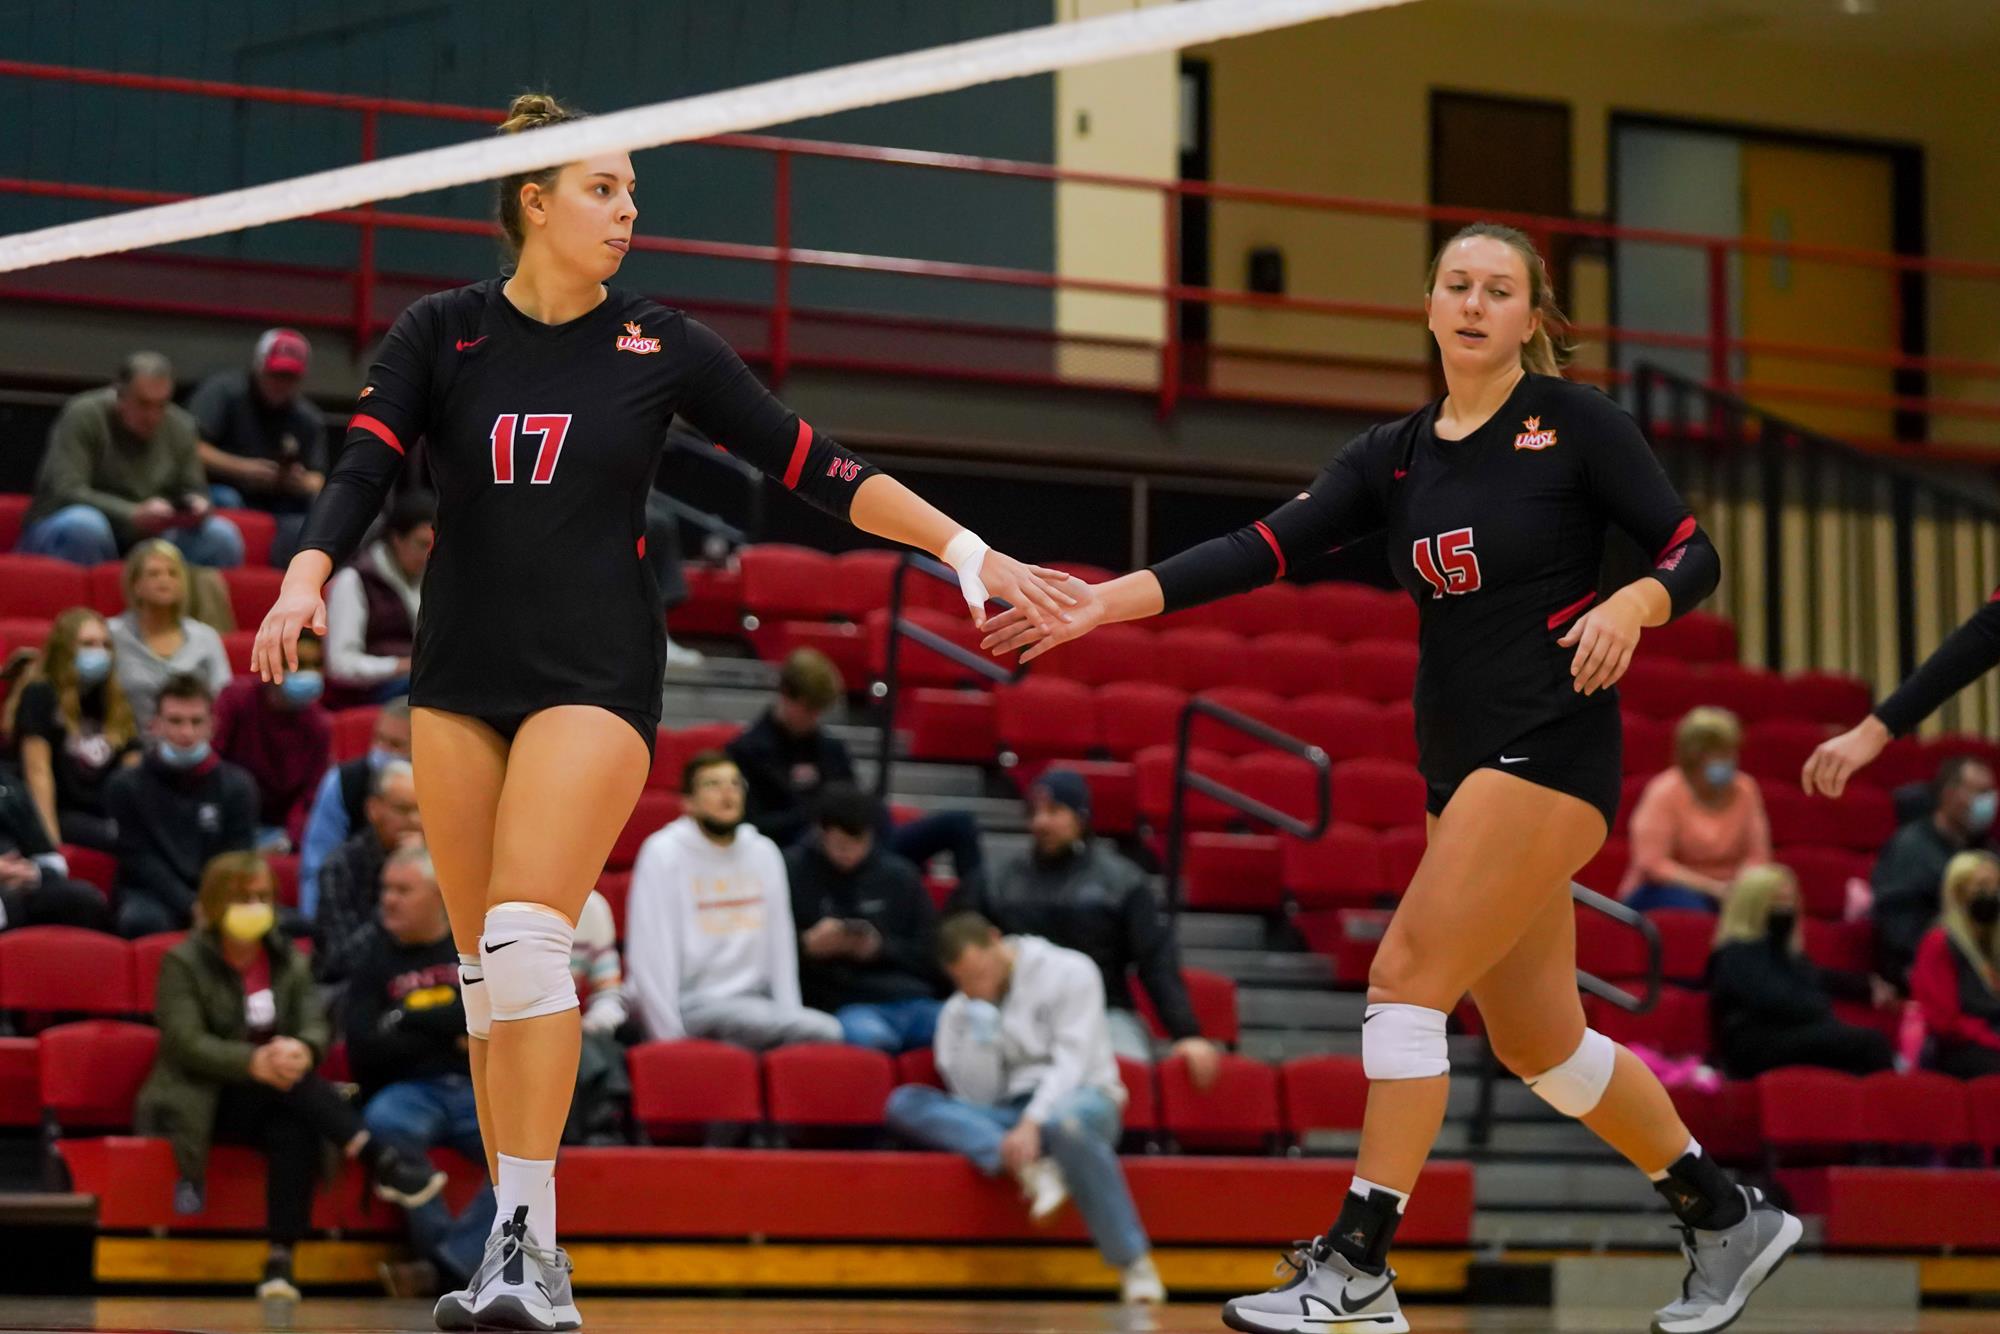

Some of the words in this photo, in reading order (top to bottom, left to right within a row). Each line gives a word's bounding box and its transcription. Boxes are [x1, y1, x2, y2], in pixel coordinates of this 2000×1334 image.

[617, 336, 660, 353] UMSL
[490, 414, 572, 484] 17
[1515, 431, 1555, 449] UMSL
[1413, 527, 1481, 599] 15
